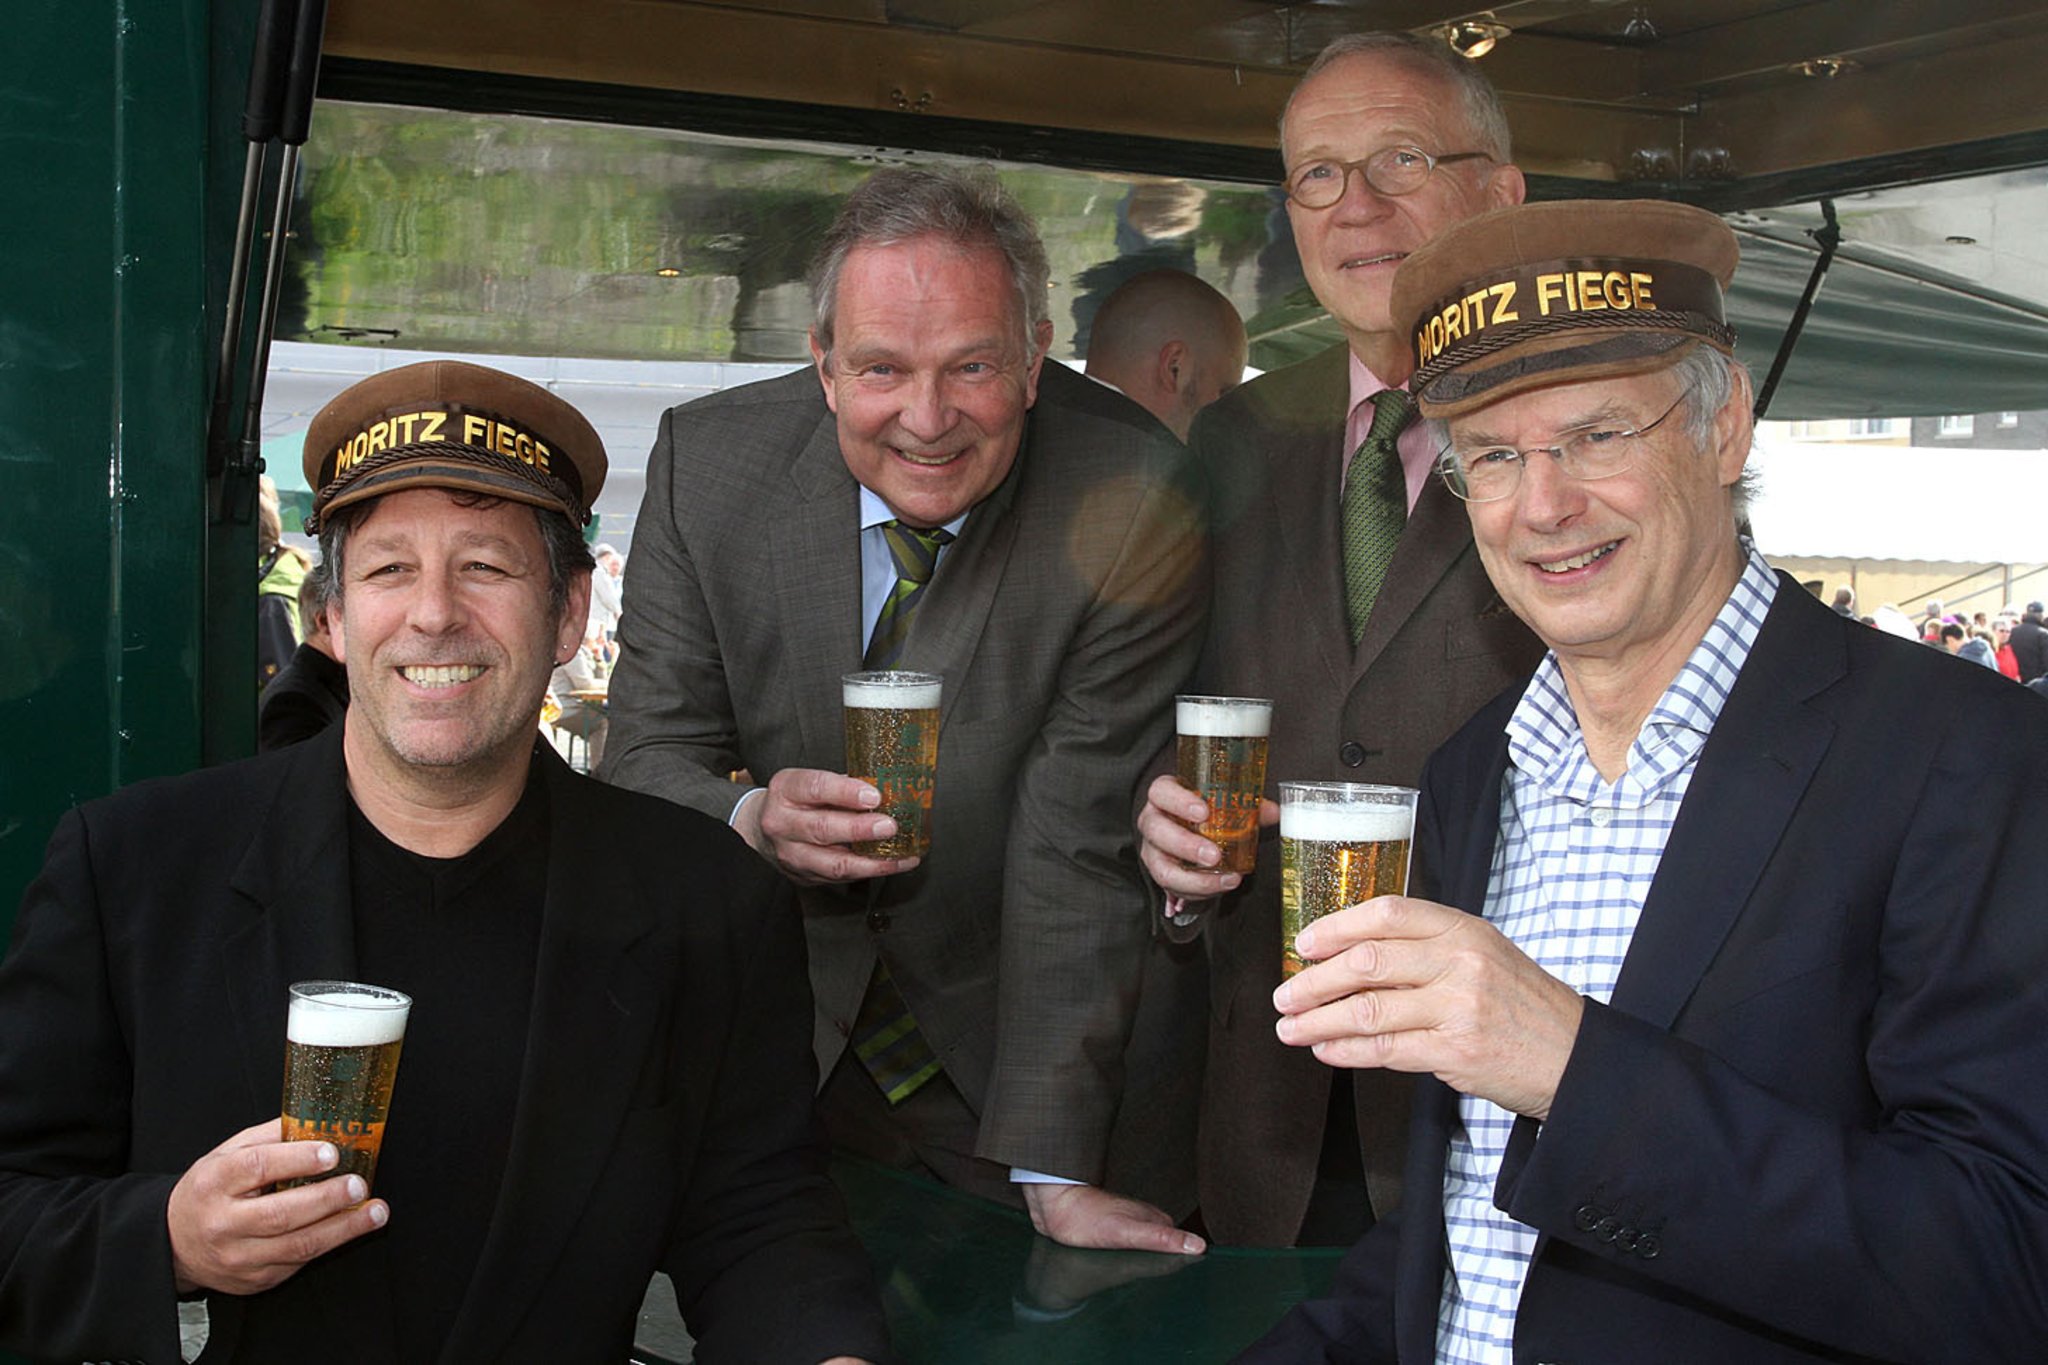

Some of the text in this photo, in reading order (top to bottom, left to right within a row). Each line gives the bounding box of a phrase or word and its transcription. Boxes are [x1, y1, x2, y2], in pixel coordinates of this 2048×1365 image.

[1418, 271, 1657, 368] MORITZ FIEGE
[335, 411, 551, 478] MORITZ FIEGE
